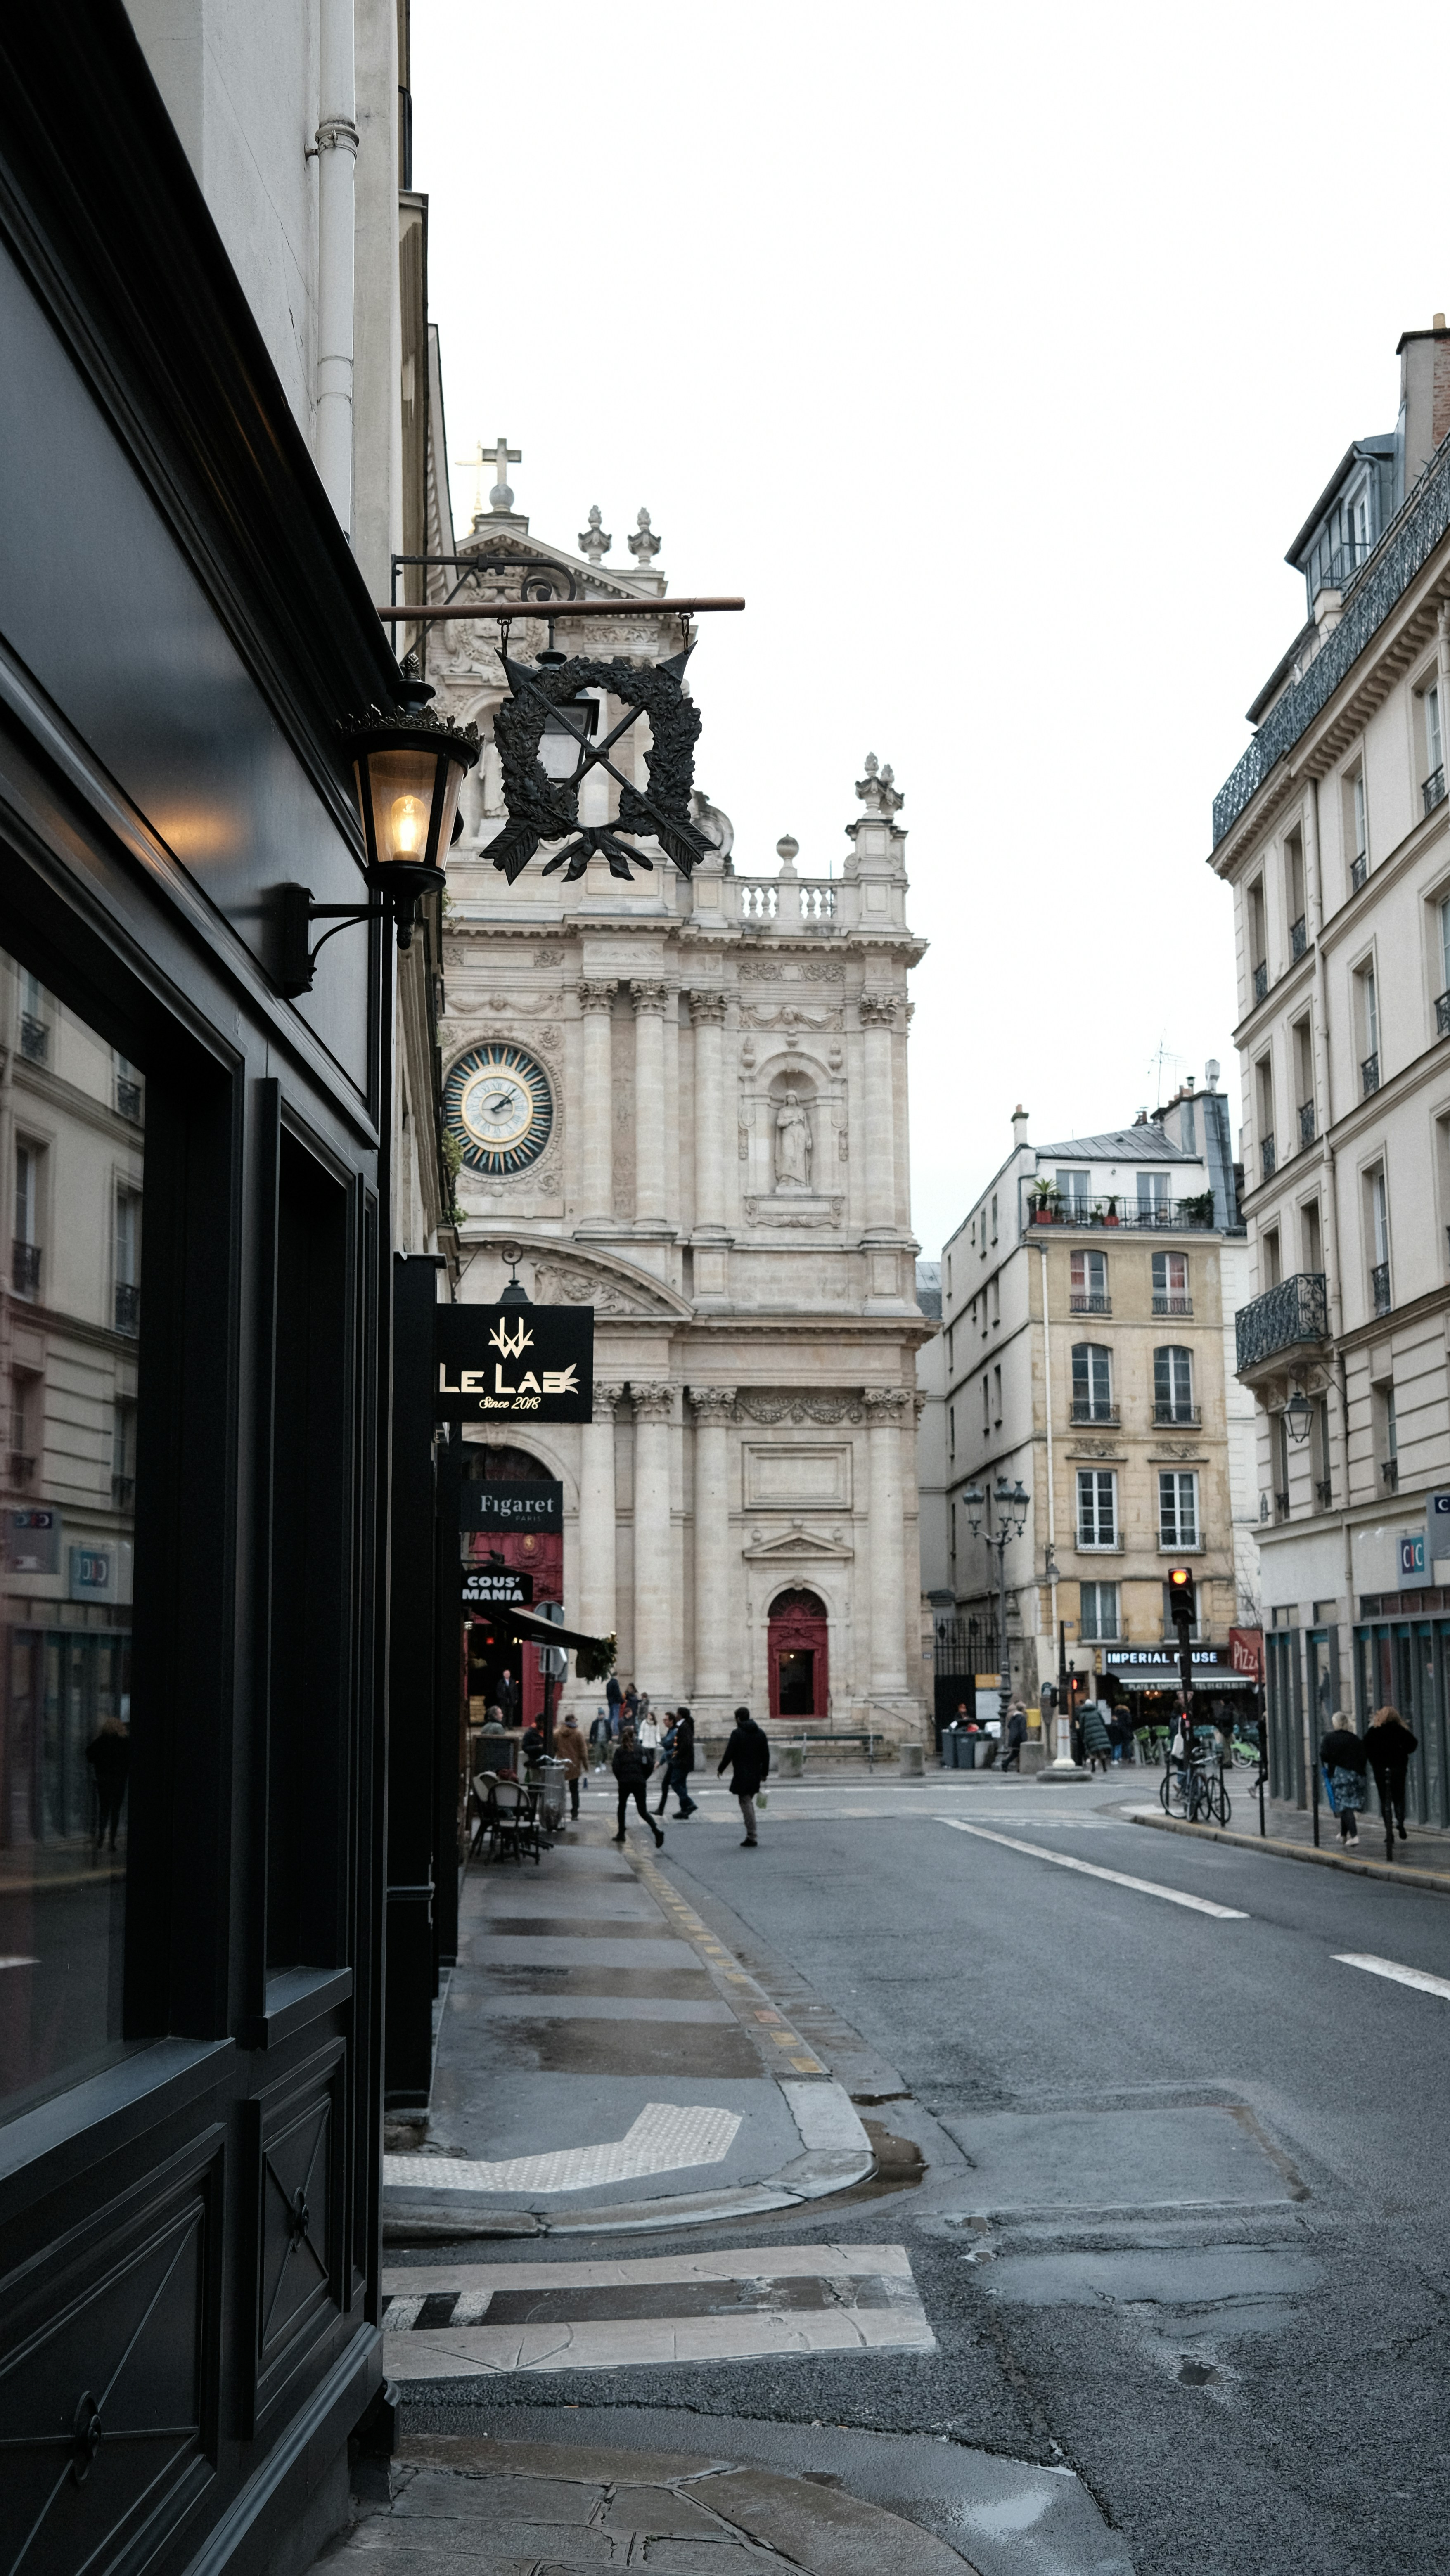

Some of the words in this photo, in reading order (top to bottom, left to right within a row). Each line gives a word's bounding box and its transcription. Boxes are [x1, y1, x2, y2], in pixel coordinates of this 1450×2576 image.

[479, 1396, 510, 1409] Since
[511, 1397, 542, 1409] 2018
[480, 1495, 554, 1517] Figaret
[1403, 1544, 1423, 1568] CIC
[462, 1589, 524, 1601] MANIA
[1107, 1652, 1170, 1664] IMPERIAL
[1174, 1652, 1218, 1664] USE
